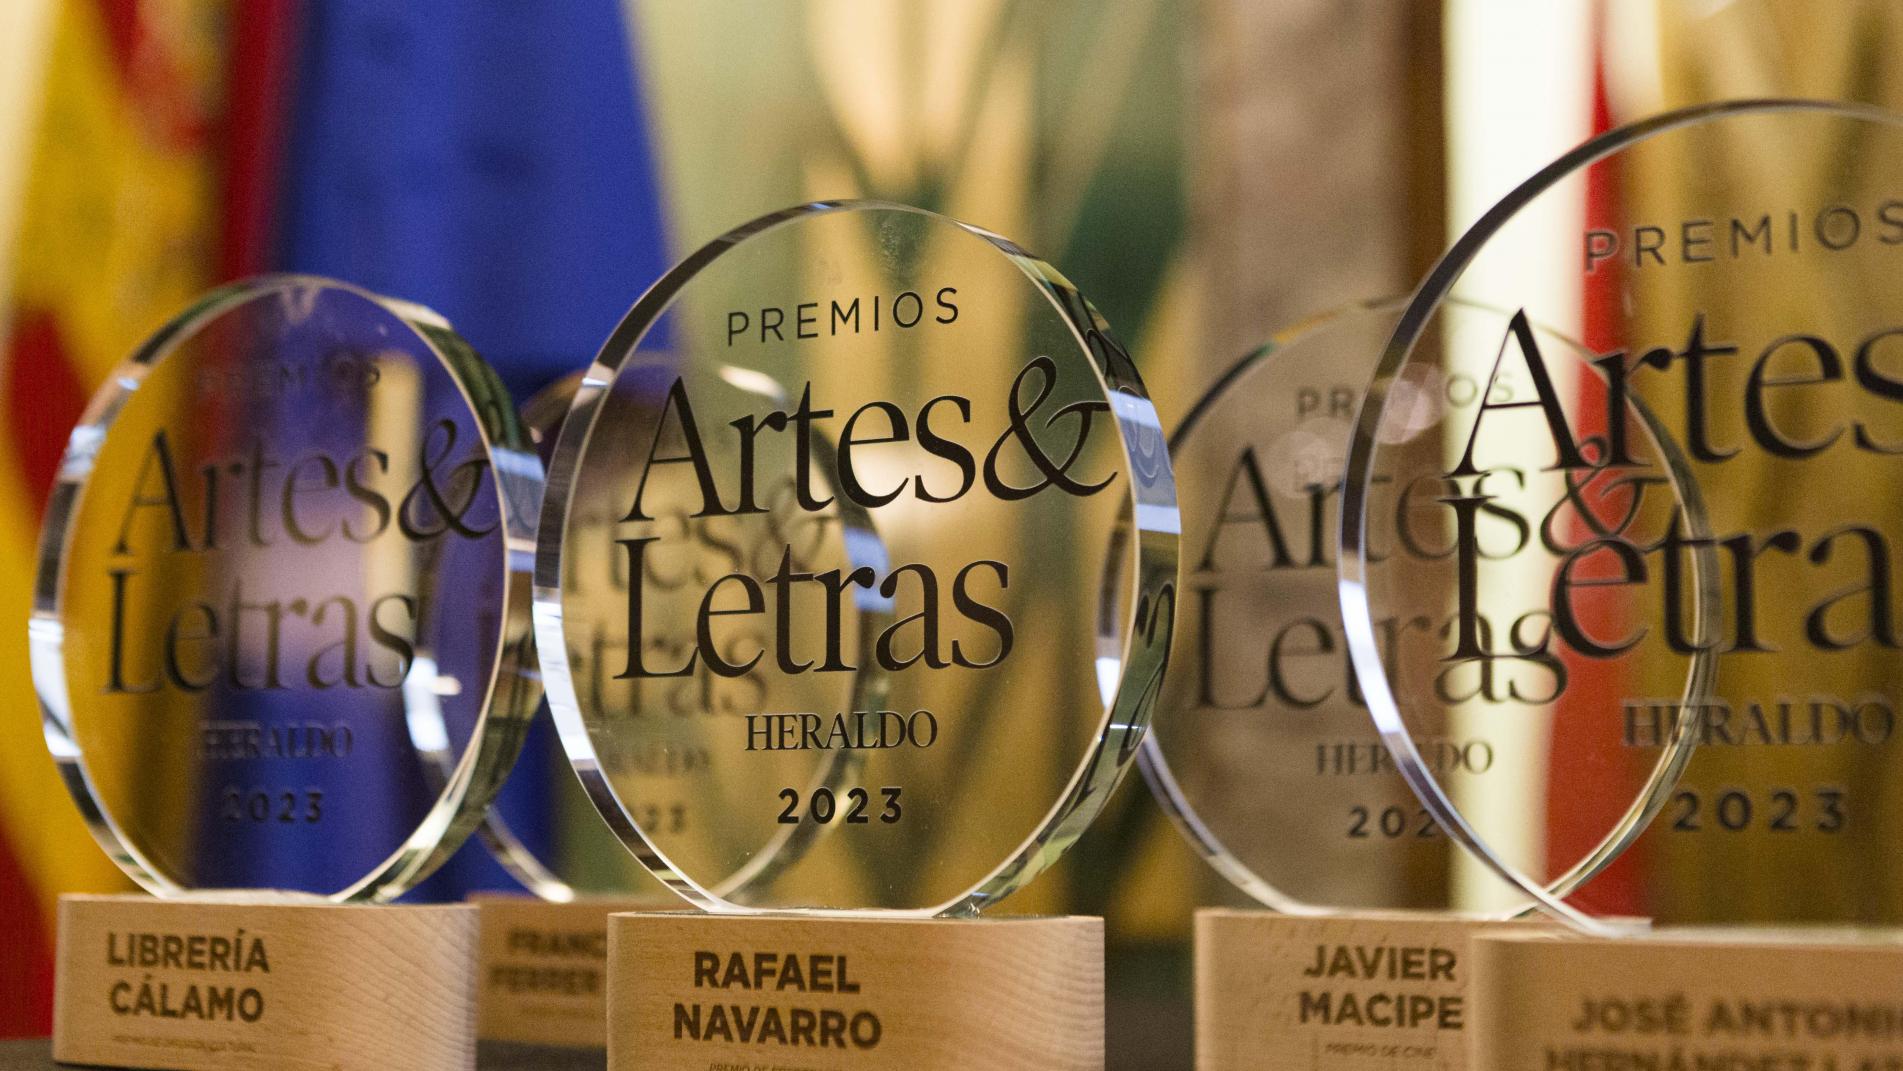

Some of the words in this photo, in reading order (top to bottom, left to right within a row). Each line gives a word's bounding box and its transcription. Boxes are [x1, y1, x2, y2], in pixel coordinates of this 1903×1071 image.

[1584, 201, 1903, 273] PREMIOS
[728, 287, 959, 347] PREMIOS
[1297, 371, 1514, 418] PROS
[619, 355, 1118, 522] Artes&
[613, 536, 1014, 679] Letras
[107, 569, 416, 694] Letras
[204, 722, 354, 758] HERALDO
[745, 710, 938, 751] HERALDO
[1622, 700, 1890, 746] HERALDO
[1316, 741, 1494, 775] HERDO
[223, 789, 324, 825] 2023
[776, 787, 902, 824] 2023
[1348, 804, 1438, 839] 202
[1672, 790, 1844, 832] 2023
[107, 928, 270, 973] LIBRERÍA
[694, 951, 861, 994] RAFAEL
[1303, 945, 1457, 981] JAVIER
[109, 973, 264, 1022] CÁLAMO
[1299, 991, 1465, 1030] MACIPE
[1570, 992, 1689, 1034] JOSÉ
[1705, 997, 1903, 1040] ANTONI
[673, 1003, 883, 1050] NAVARRO
